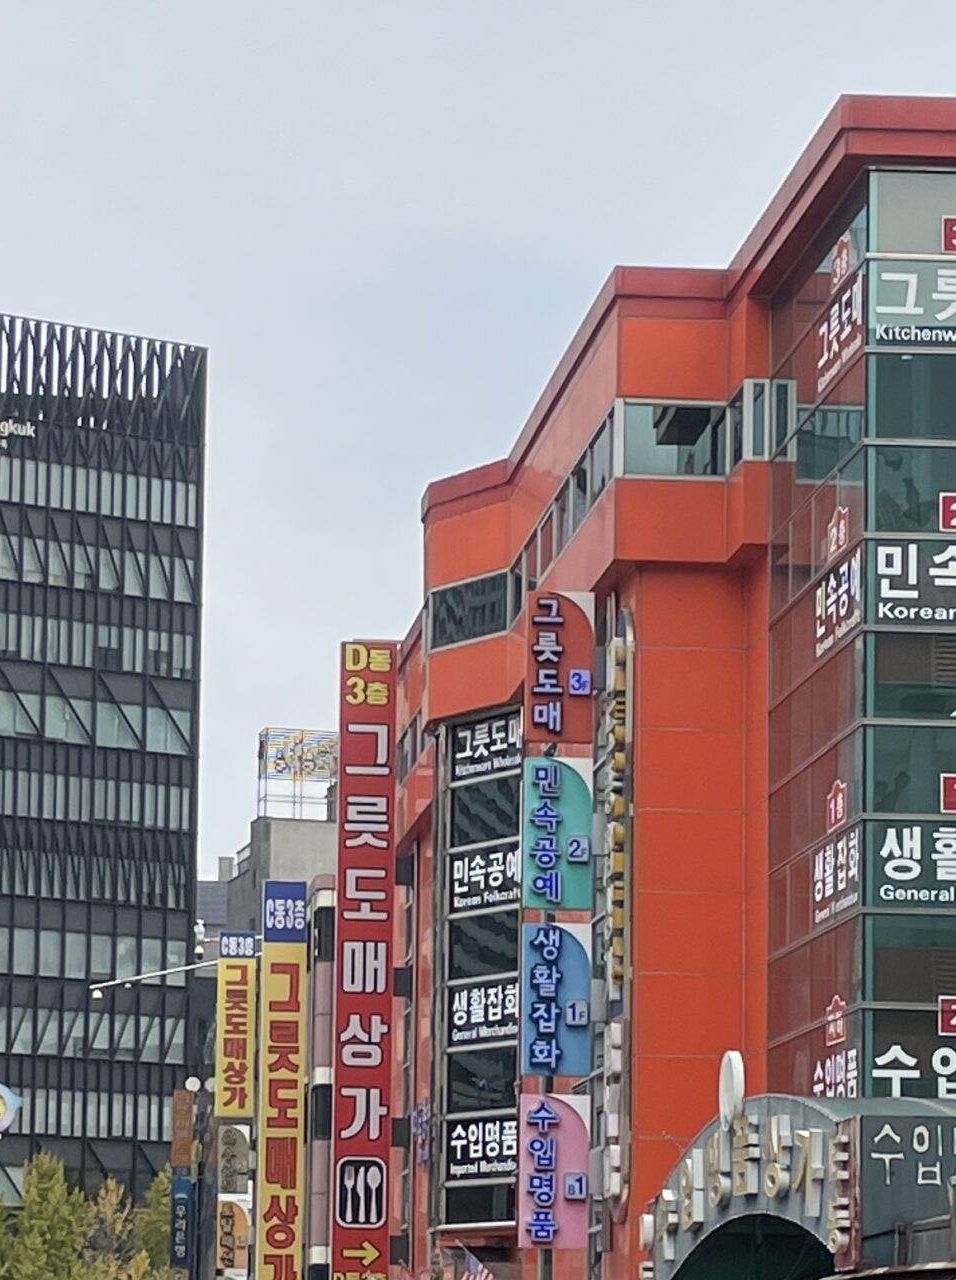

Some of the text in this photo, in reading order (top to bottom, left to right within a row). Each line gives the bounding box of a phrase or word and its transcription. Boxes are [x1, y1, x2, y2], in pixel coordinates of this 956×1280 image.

[818, 271, 862, 369] 그릇도매
[816, 547, 861, 638] 민속공예
[346, 645, 392, 672] D동
[346, 677, 389, 705] 3층
[532, 598, 564, 732] 그릇도매
[571, 673, 588, 691] 3F
[531, 765, 563, 903] 민속공예
[814, 828, 859, 902] 생활잡화
[265, 899, 306, 931] C동3층
[880, 884, 955, 901] General
[221, 937, 254, 955] C동3층
[340, 724, 391, 1142] 그릇도매상가
[531, 927, 561, 1068] 생활잡화
[222, 964, 249, 1109] 그릇도매상가
[450, 1120, 517, 1160] 수입명품
[527, 1102, 559, 1242] 수입명품
[870, 1124, 956, 1186] 수입
[658, 1112, 826, 1262] 수입명품상가
[175, 1204, 187, 1258] 우리은행
